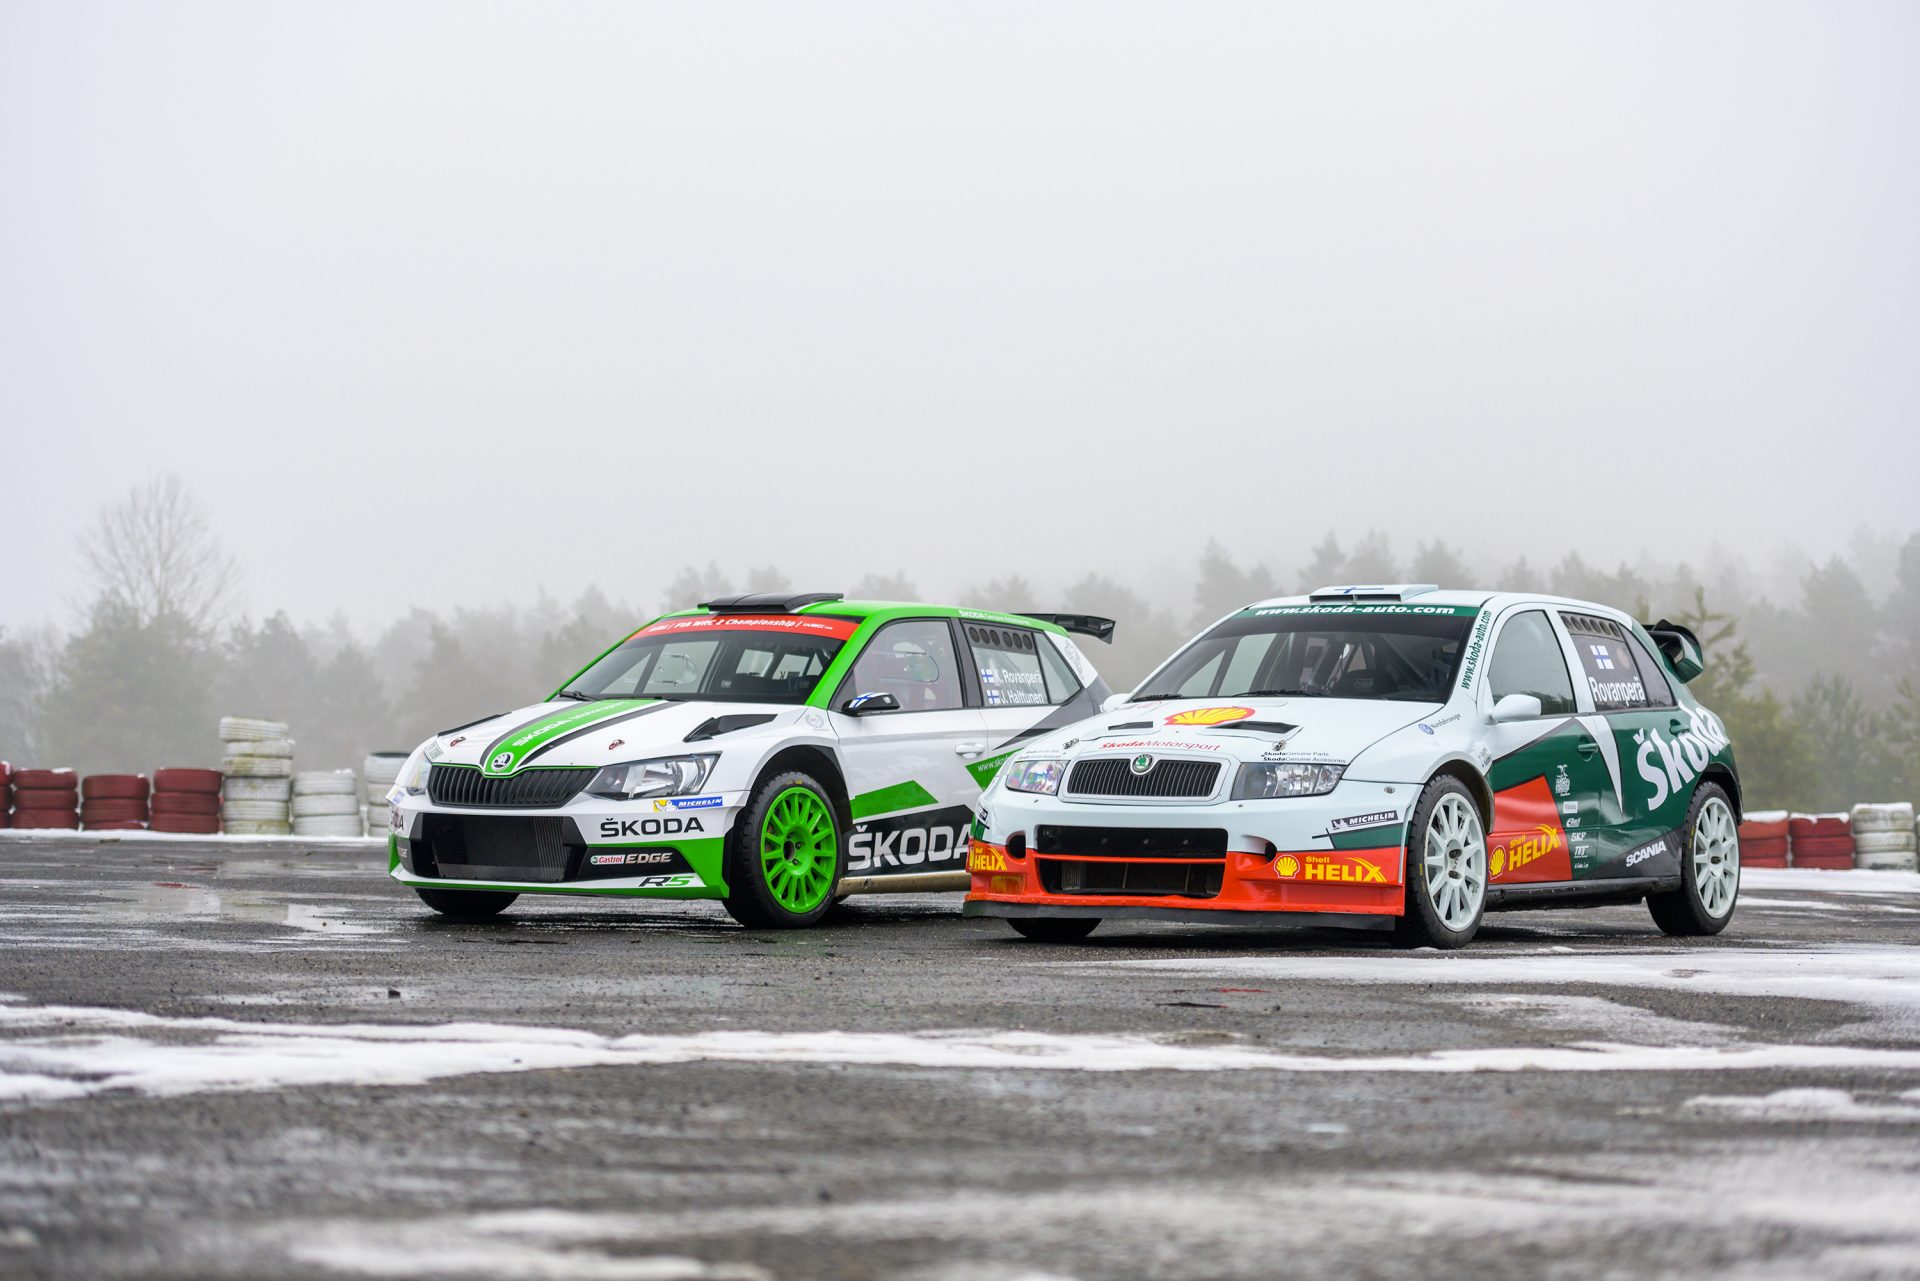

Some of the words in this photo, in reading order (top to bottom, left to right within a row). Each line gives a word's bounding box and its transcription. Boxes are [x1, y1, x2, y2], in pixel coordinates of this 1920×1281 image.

[1255, 605, 1455, 616] www.skoda-auto.com
[692, 619, 715, 627] WRC
[726, 618, 796, 628] Championship
[1461, 610, 1492, 690] www.skoda-auto.com
[1588, 676, 1646, 707] Rovanperä
[1633, 699, 1730, 811] Škoda
[678, 798, 722, 807] MICHELIN
[600, 817, 705, 838] ŠKODA
[1349, 811, 1395, 825] MICHELIN
[598, 855, 623, 864] Castrol
[625, 852, 673, 864] EDGE
[847, 824, 971, 871] ŠKODA
[1508, 824, 1561, 871] HELIX
[1626, 840, 1667, 868] SCANIA
[974, 848, 1008, 871] HELIX
[1305, 855, 1330, 864] Shell
[1305, 857, 1387, 882] HELIX
[639, 876, 695, 888] R5
